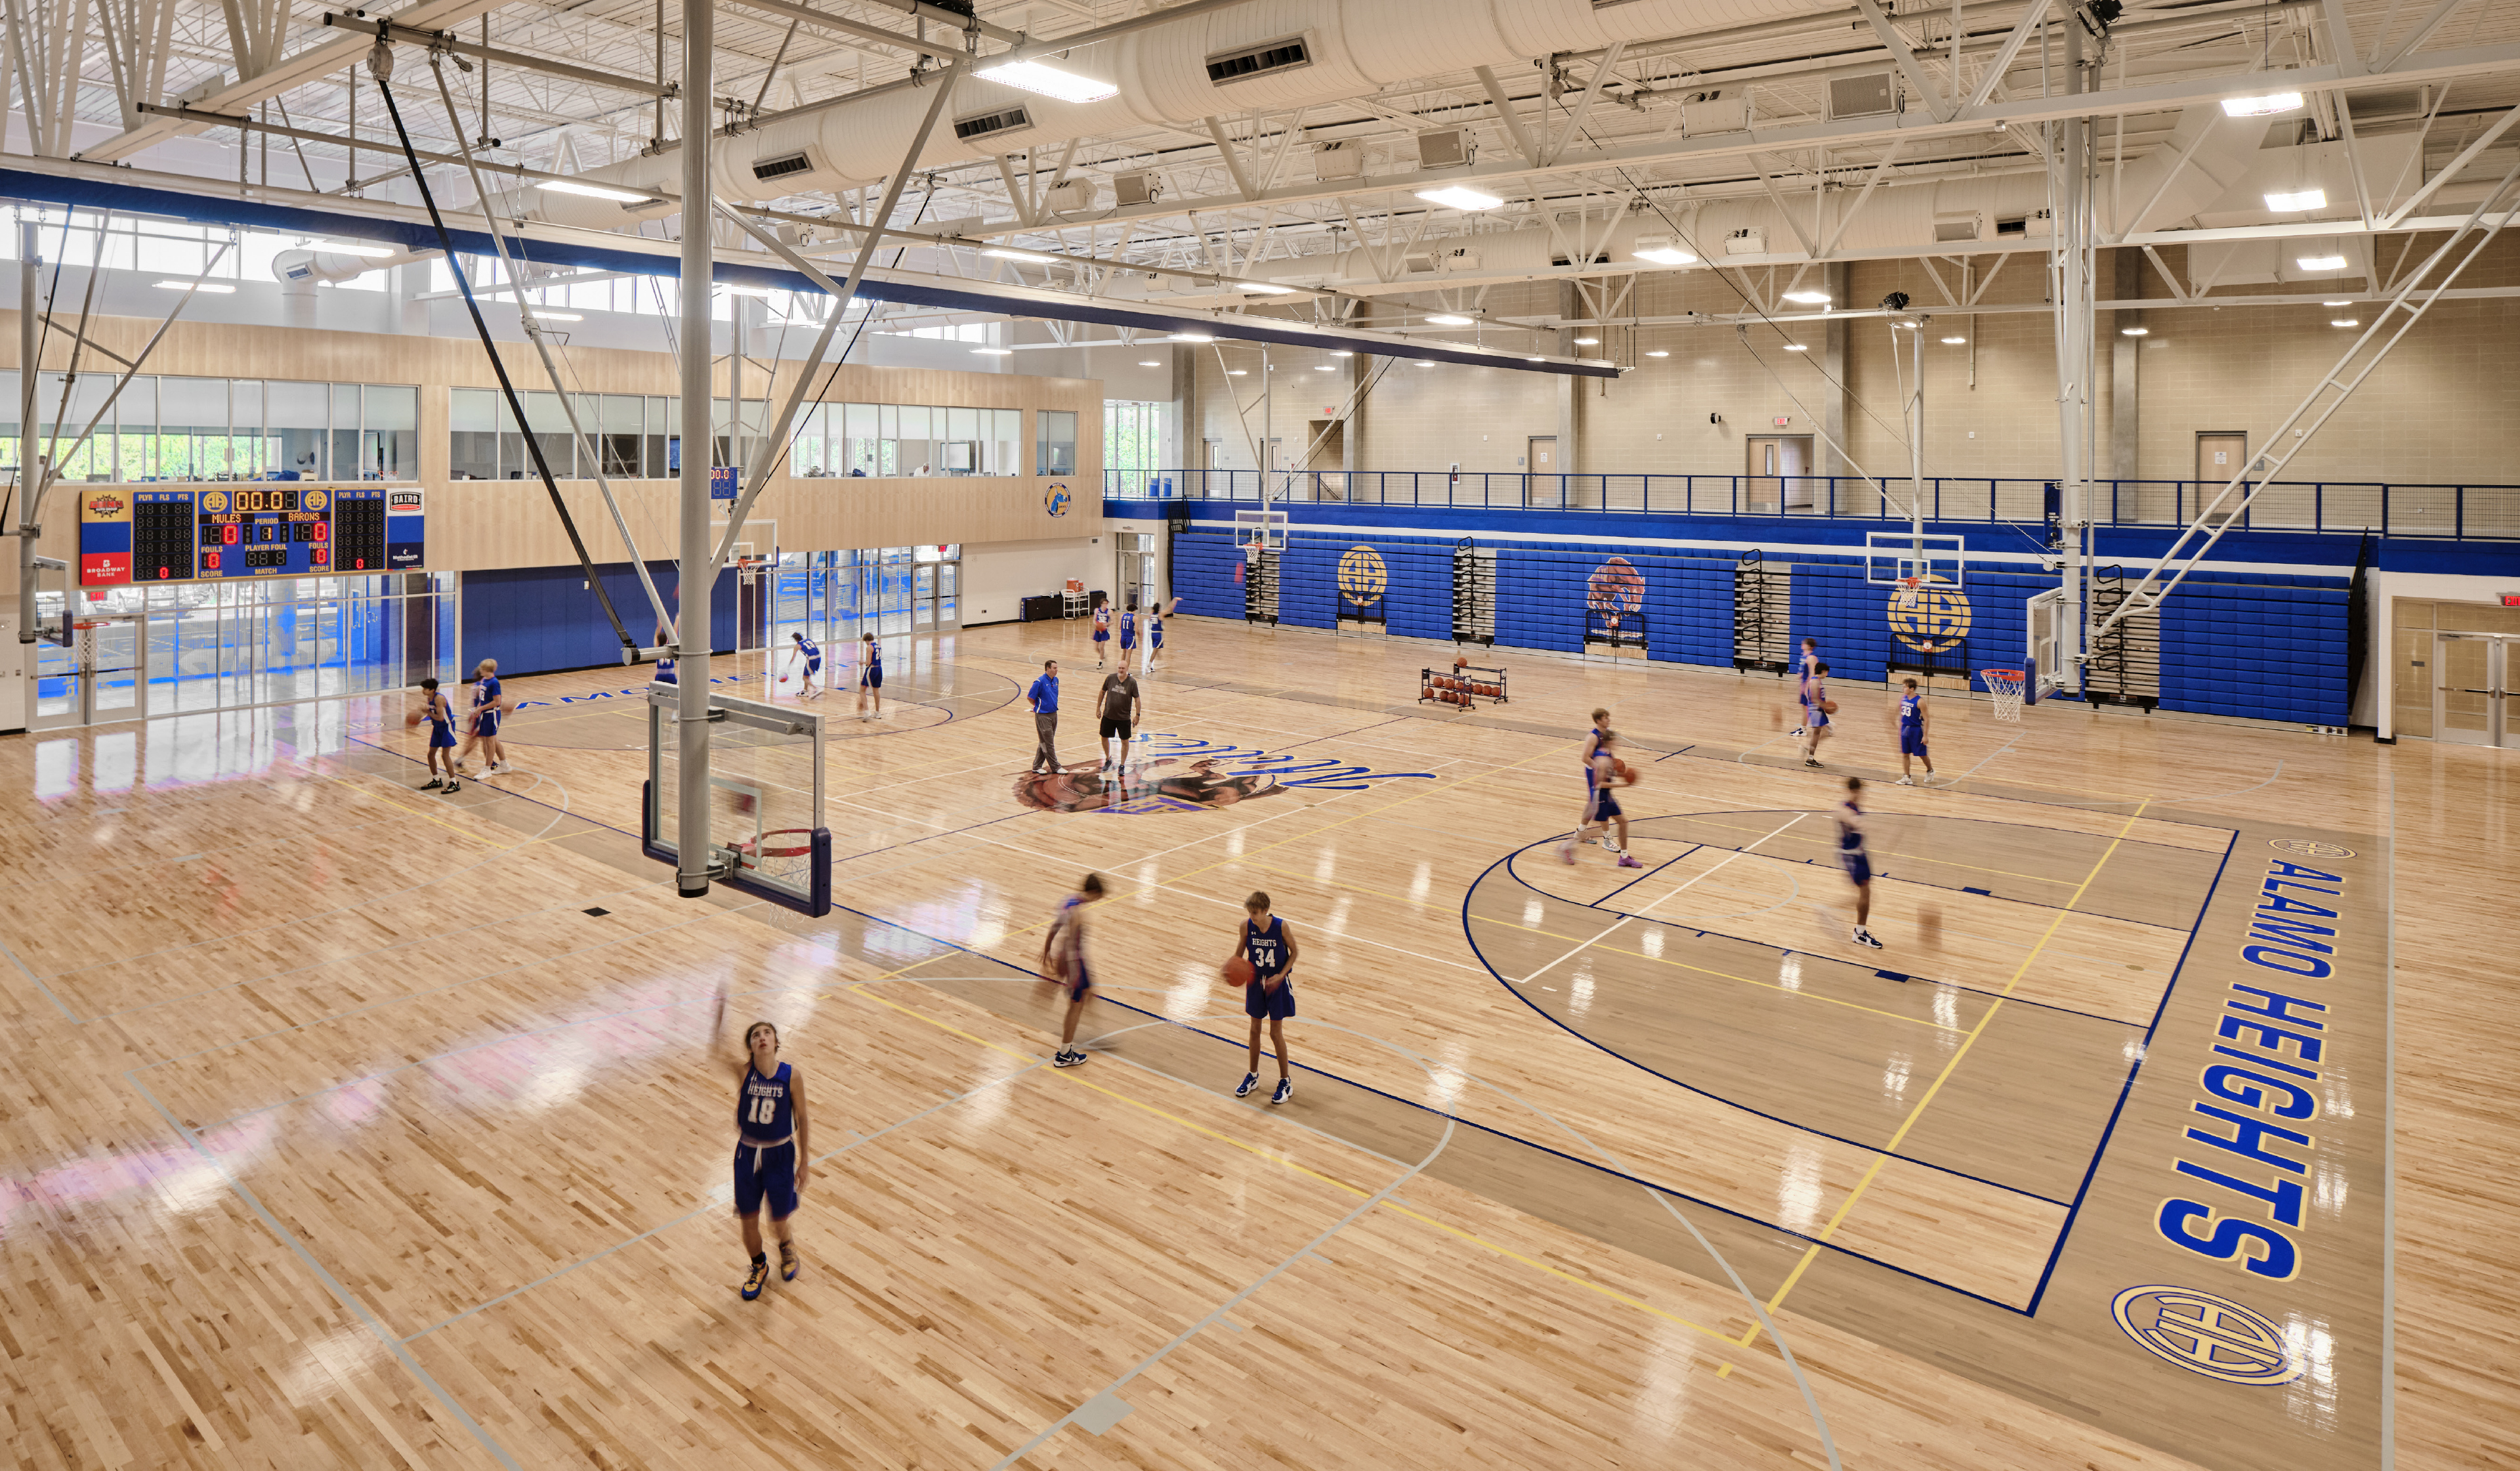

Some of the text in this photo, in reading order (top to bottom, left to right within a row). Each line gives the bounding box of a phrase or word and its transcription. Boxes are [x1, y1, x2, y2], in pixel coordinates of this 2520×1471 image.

[394, 494, 418, 504] BAIRD
[211, 513, 242, 524] MULES
[288, 512, 320, 522] BARONS
[224, 524, 237, 544] 0
[314, 523, 327, 541] 0
[208, 553, 220, 568] 0
[316, 549, 327, 564] 0
[356, 559, 364, 569] 0
[159, 567, 168, 579] 0
[91, 591, 104, 601] EXIT
[1122, 620, 1129, 629] 11
[1900, 706, 1912, 717] 33
[1251, 937, 1277, 948] HEIGHTS
[1255, 948, 1275, 968] 34
[2154, 857, 2347, 1283] ALAMO HEIGHTS
[747, 1084, 784, 1098] HEIGHTS
[748, 1098, 776, 1124] 18
